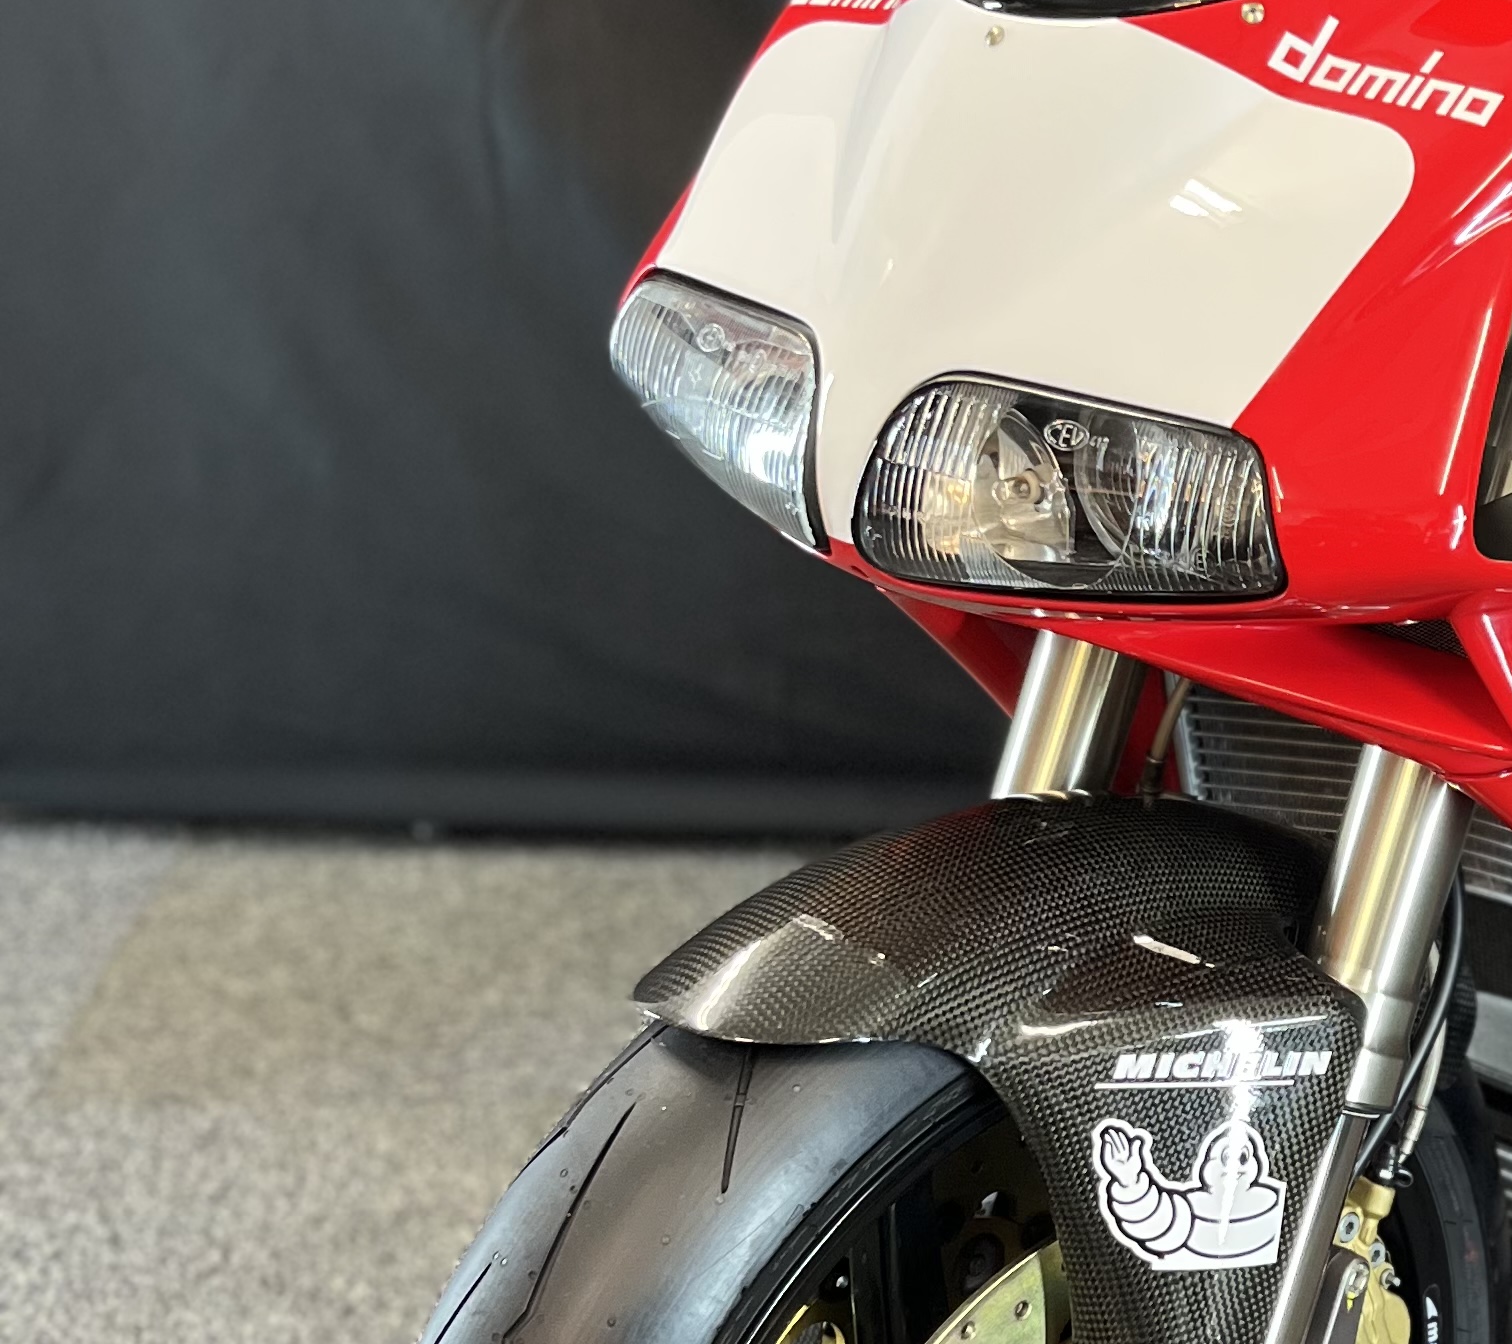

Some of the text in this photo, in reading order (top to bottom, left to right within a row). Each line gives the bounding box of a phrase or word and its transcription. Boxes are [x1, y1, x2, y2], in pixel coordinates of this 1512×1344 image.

[1266, 14, 1505, 127] domino
[1047, 423, 1086, 448] CEV
[1111, 1050, 1333, 1081] MICHELIN
